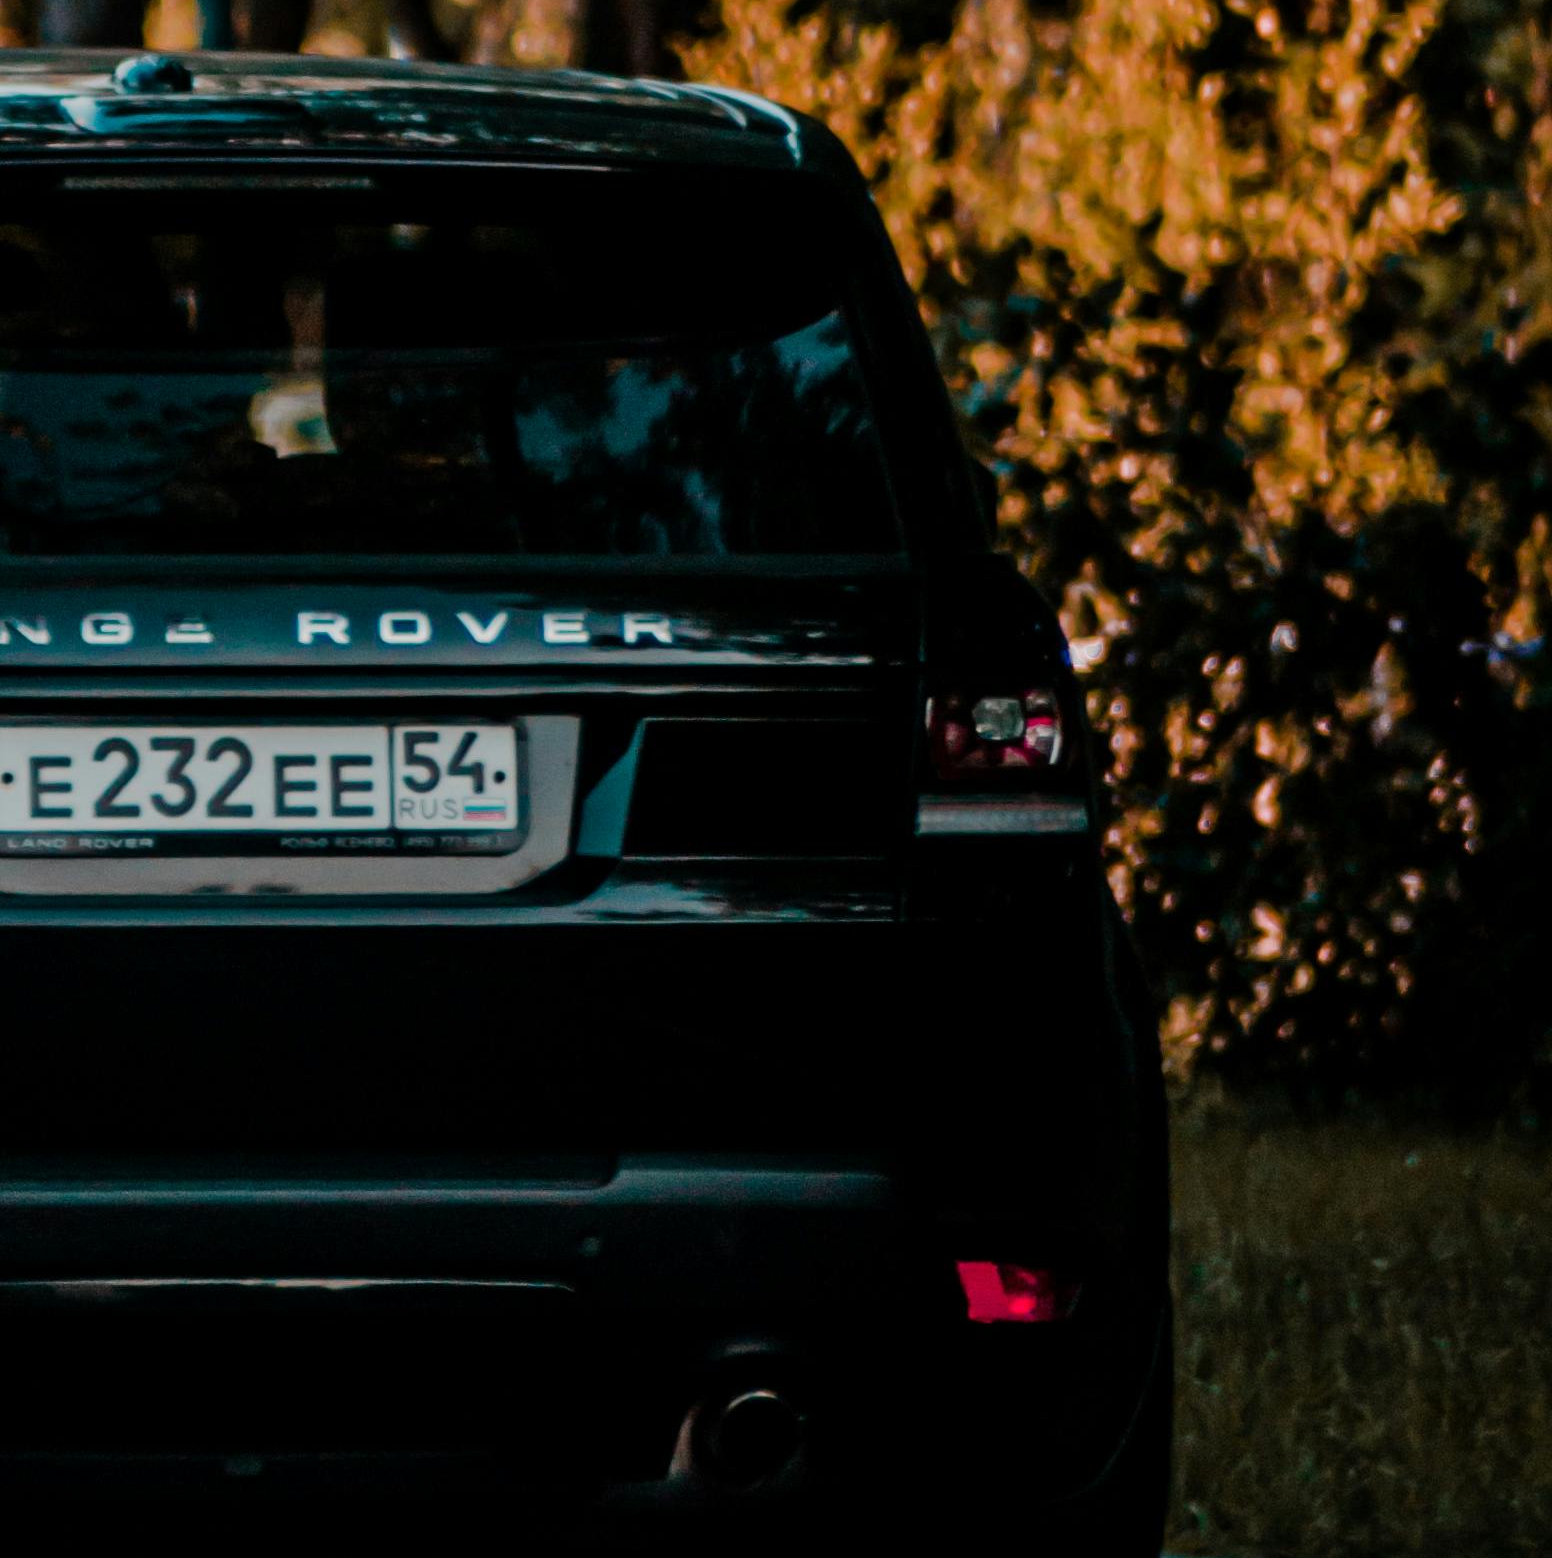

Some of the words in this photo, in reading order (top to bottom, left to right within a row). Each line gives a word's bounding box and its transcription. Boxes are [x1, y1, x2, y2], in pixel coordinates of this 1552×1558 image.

[297, 611, 674, 644] ROVER
[29, 737, 374, 819] E232EE
[402, 731, 486, 794] 54
[400, 799, 460, 820] RUS
[7, 837, 67, 849] LAND
[78, 837, 154, 849] ROVER
